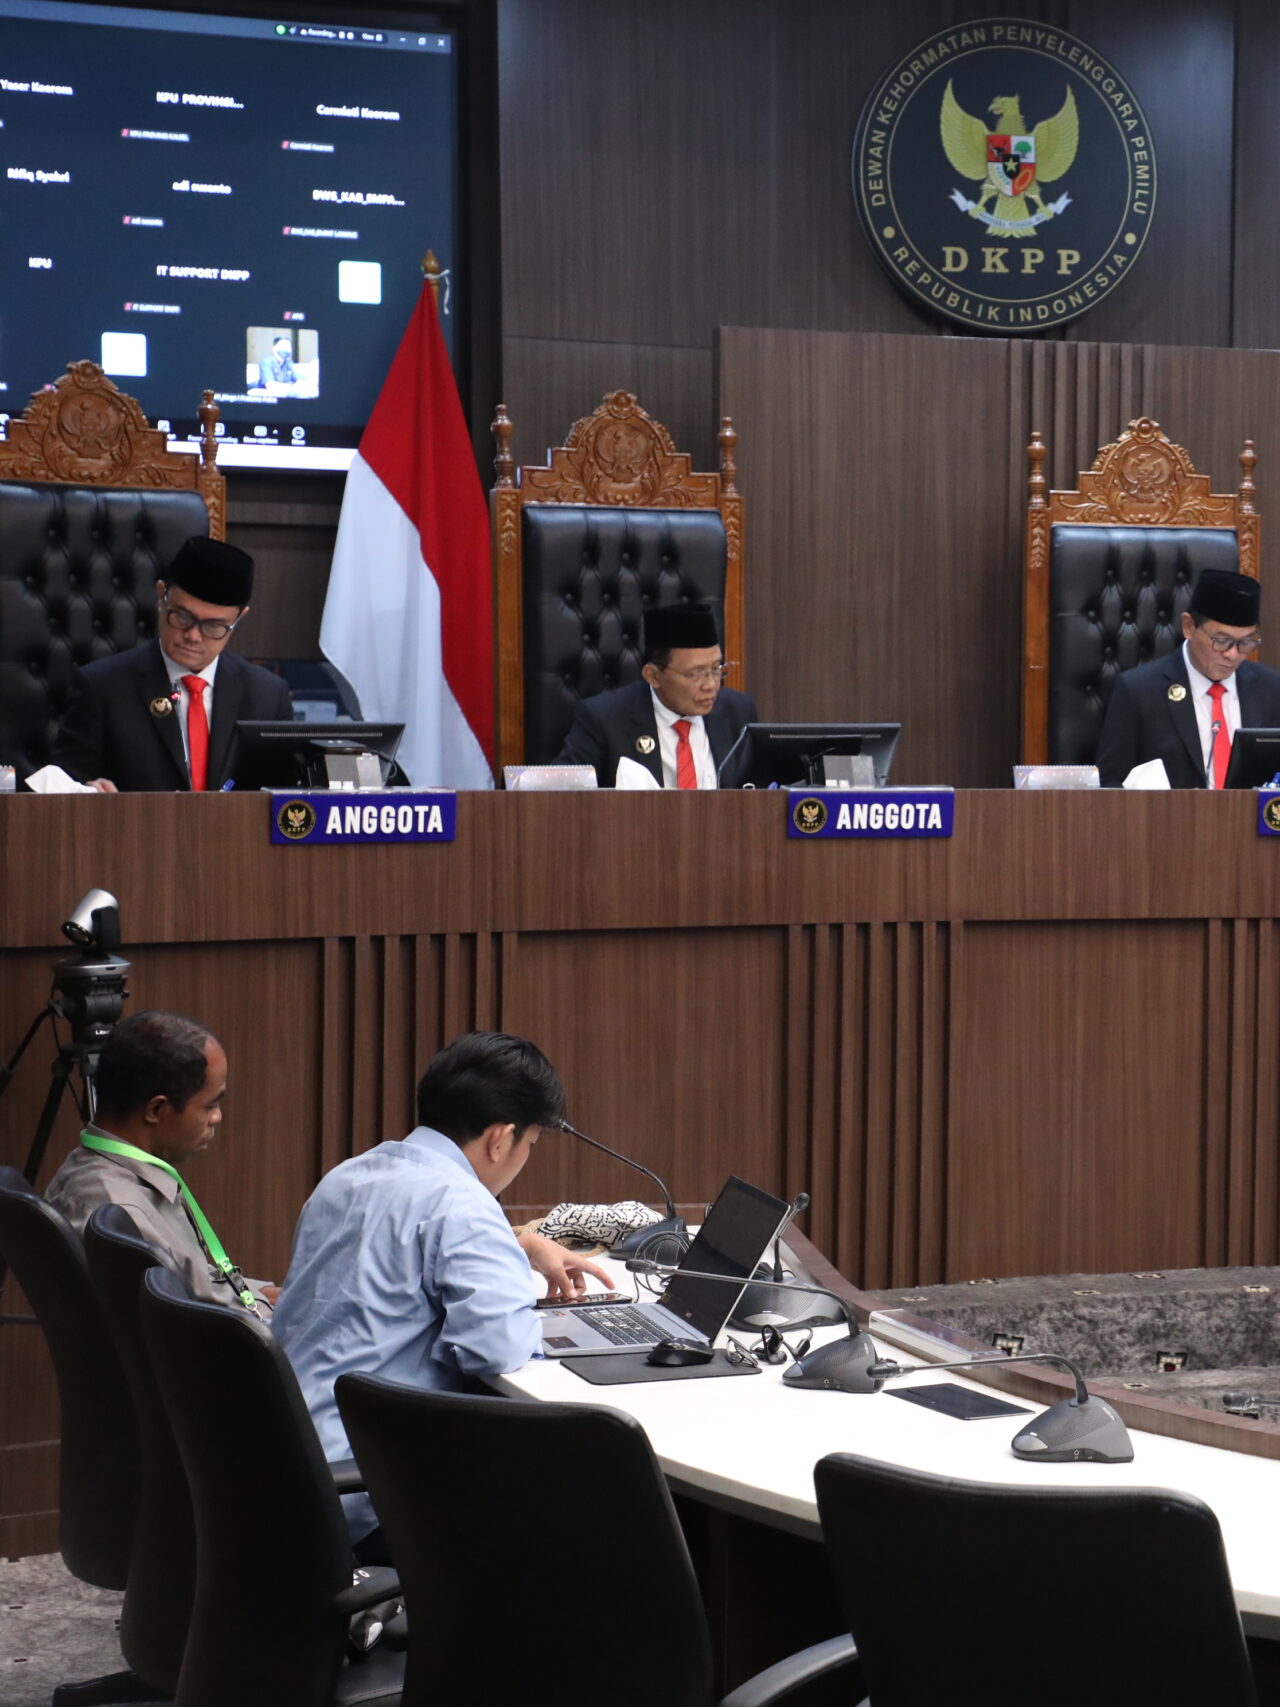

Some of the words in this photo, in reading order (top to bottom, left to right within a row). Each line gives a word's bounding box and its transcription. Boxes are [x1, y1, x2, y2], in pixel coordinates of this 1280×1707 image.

[156, 92, 180, 103] KPU
[869, 129, 887, 206] DEWAN
[878, 27, 987, 127] KEHORMATAN
[992, 25, 1139, 132] PENYELENGGARA
[1130, 135, 1150, 215] PEMILU
[29, 256, 52, 269] KPU
[169, 266, 219, 279] SUPPORT
[942, 246, 1081, 275] DKPP
[893, 246, 1001, 322] REPUBLIK
[1009, 253, 1128, 323] INDONESIA
[326, 805, 444, 835] ANGGOTA
[836, 803, 942, 830] ANGGOTA
